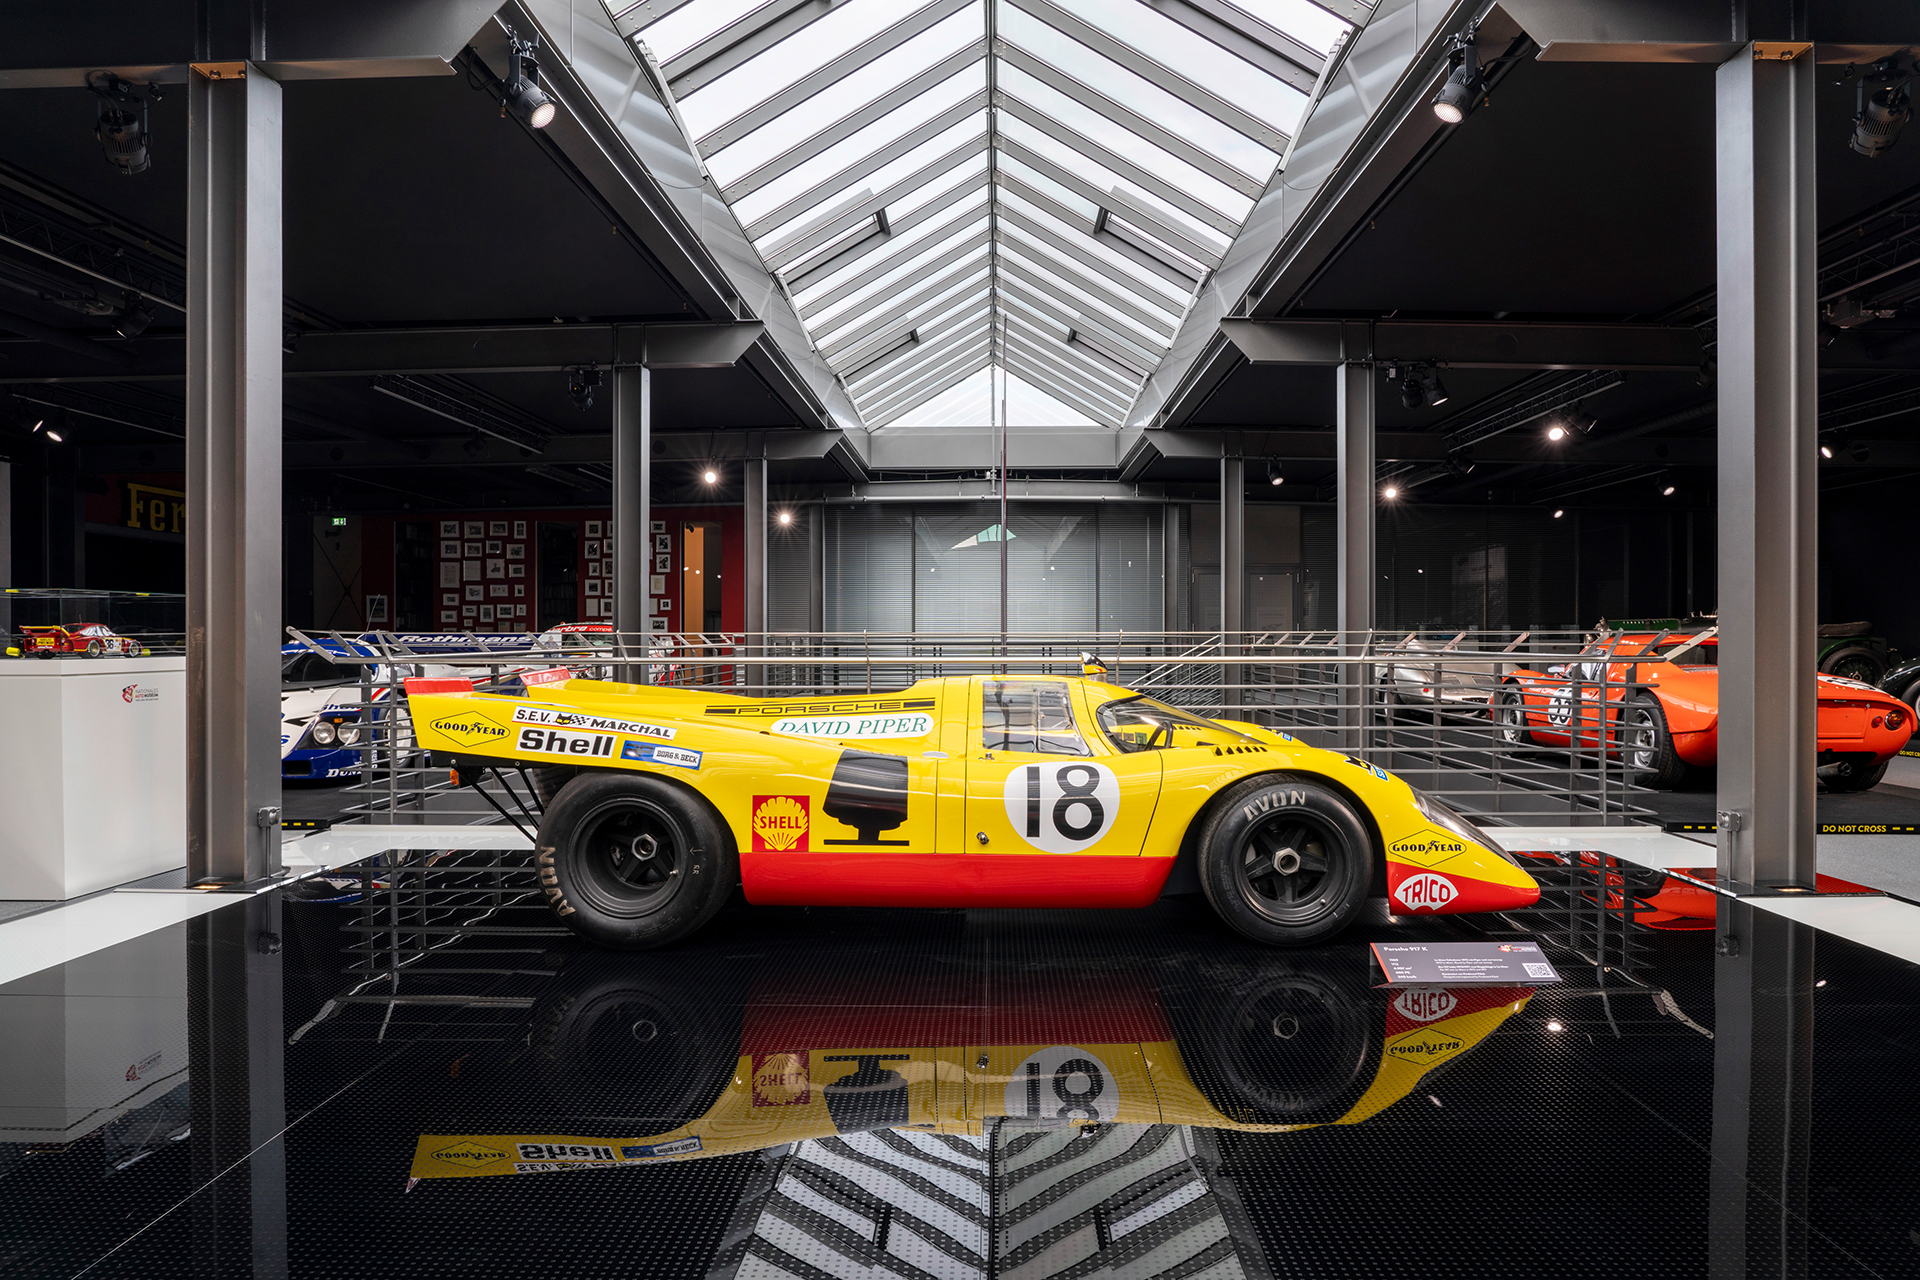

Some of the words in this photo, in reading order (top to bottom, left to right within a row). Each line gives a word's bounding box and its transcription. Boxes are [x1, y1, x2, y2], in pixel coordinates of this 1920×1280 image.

[127, 482, 186, 533] Fer
[398, 634, 534, 645] Rothmans
[737, 701, 901, 715] PORSCHE
[435, 721, 468, 732] GOOD
[476, 725, 506, 736] YEAR
[516, 709, 551, 723] S.E.V.
[590, 719, 671, 737] MARCHAL
[780, 721, 850, 735] DAVID
[856, 717, 927, 735] PIPER
[520, 729, 614, 756] Shell
[656, 749, 674, 757] BORG
[680, 754, 698, 764] BECK
[1026, 764, 1105, 841] 18
[1242, 789, 1306, 821] AVON
[760, 816, 802, 829] SHELL
[1822, 825, 1836, 833] DO
[1838, 825, 1857, 833] NOT
[1858, 824, 1887, 833] CROSS
[1392, 843, 1426, 852] GOOD
[1433, 843, 1462, 852] YEAR
[539, 846, 576, 917] AVON
[1402, 875, 1451, 903] TRICO
